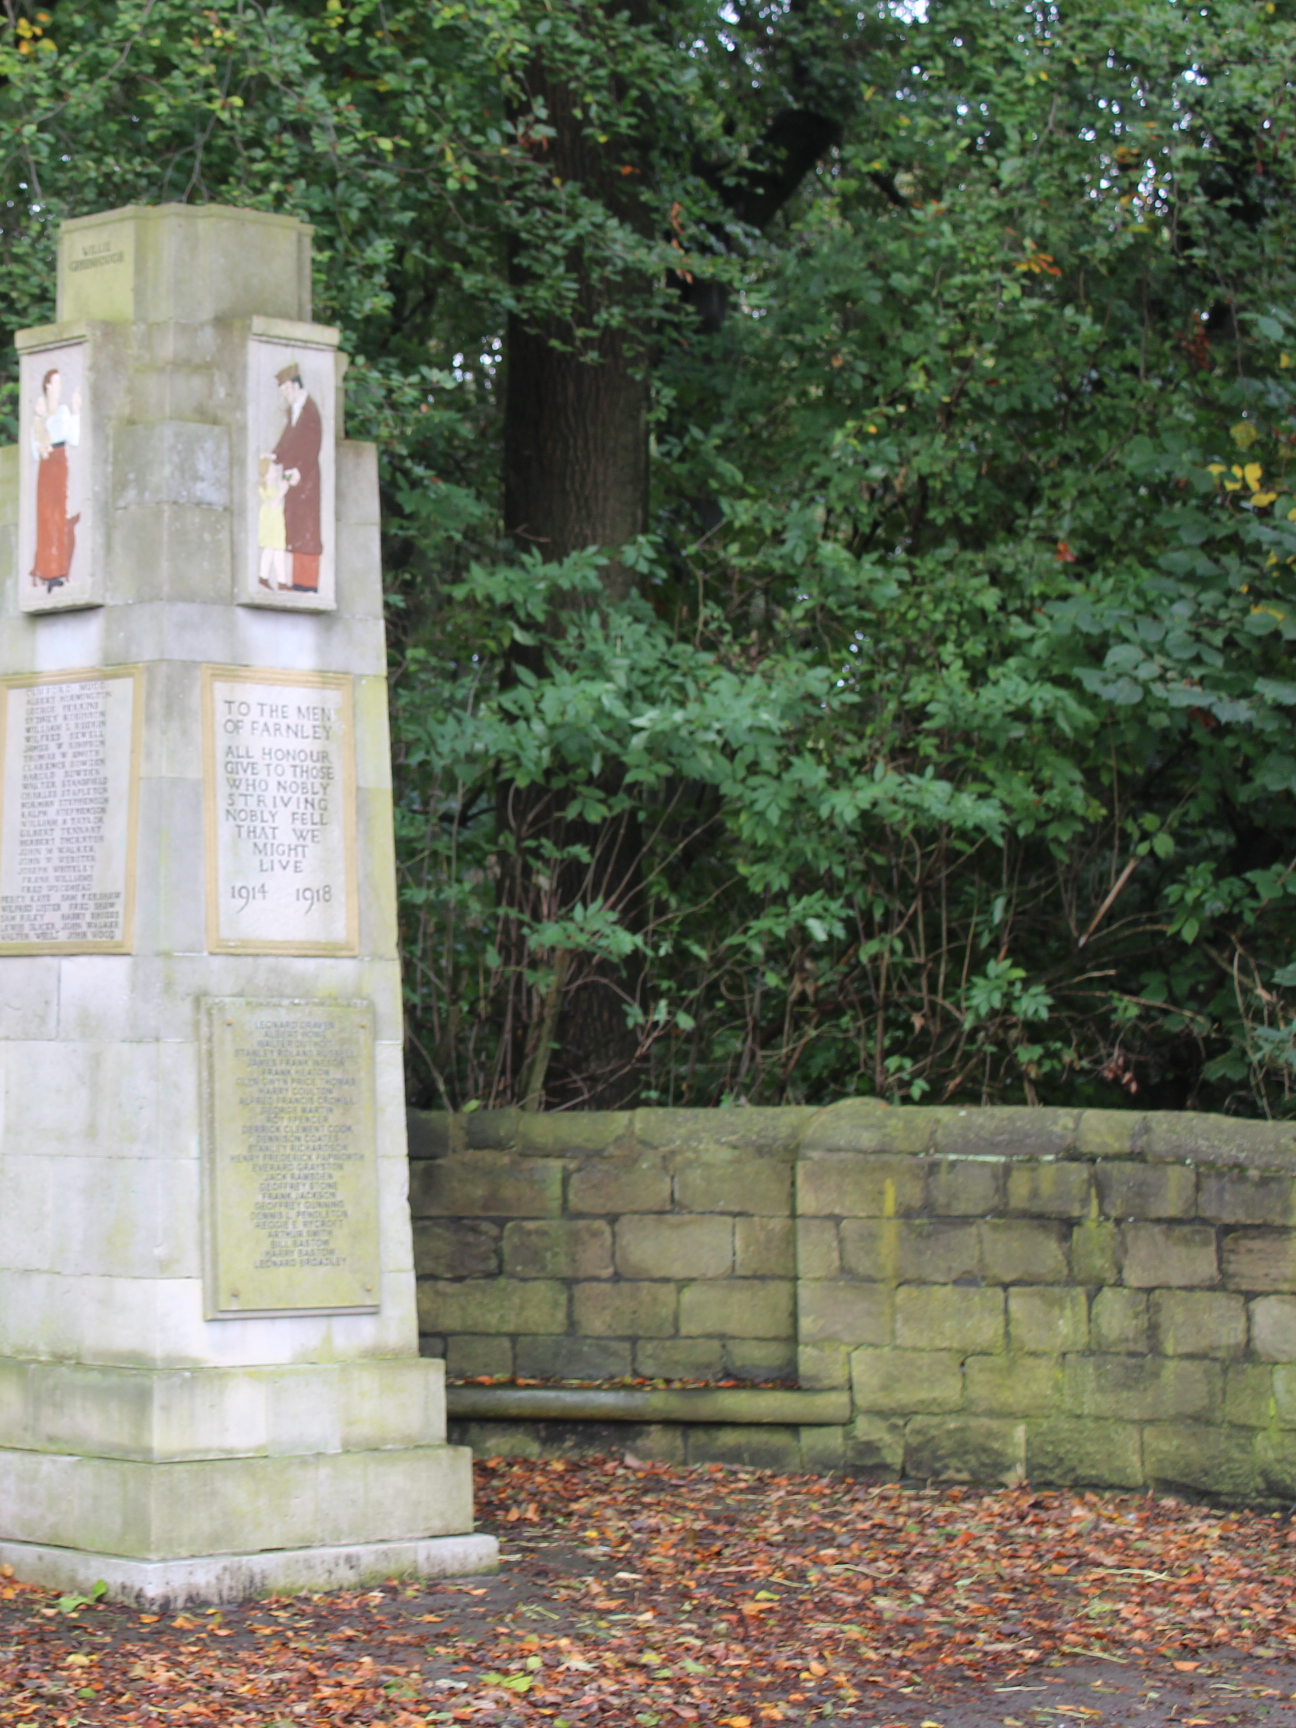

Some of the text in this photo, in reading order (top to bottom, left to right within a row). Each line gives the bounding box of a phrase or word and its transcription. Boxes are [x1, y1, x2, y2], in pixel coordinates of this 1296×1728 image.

[224, 700, 332, 723] TO THE MEN
[223, 719, 333, 740] OF FARNLEY
[225, 745, 332, 764] ALL HONOUR
[224, 761, 334, 780] GIVE TO THOSE
[226, 777, 331, 796] WHO NOBLY
[228, 793, 328, 811] STRIVING
[225, 809, 329, 826] NOBLY FELL
[235, 825, 321, 844] THAT WE
[252, 842, 309, 859] MIGHT
[259, 859, 304, 873] LIVE
[231, 882, 333, 915] 1914 1918
